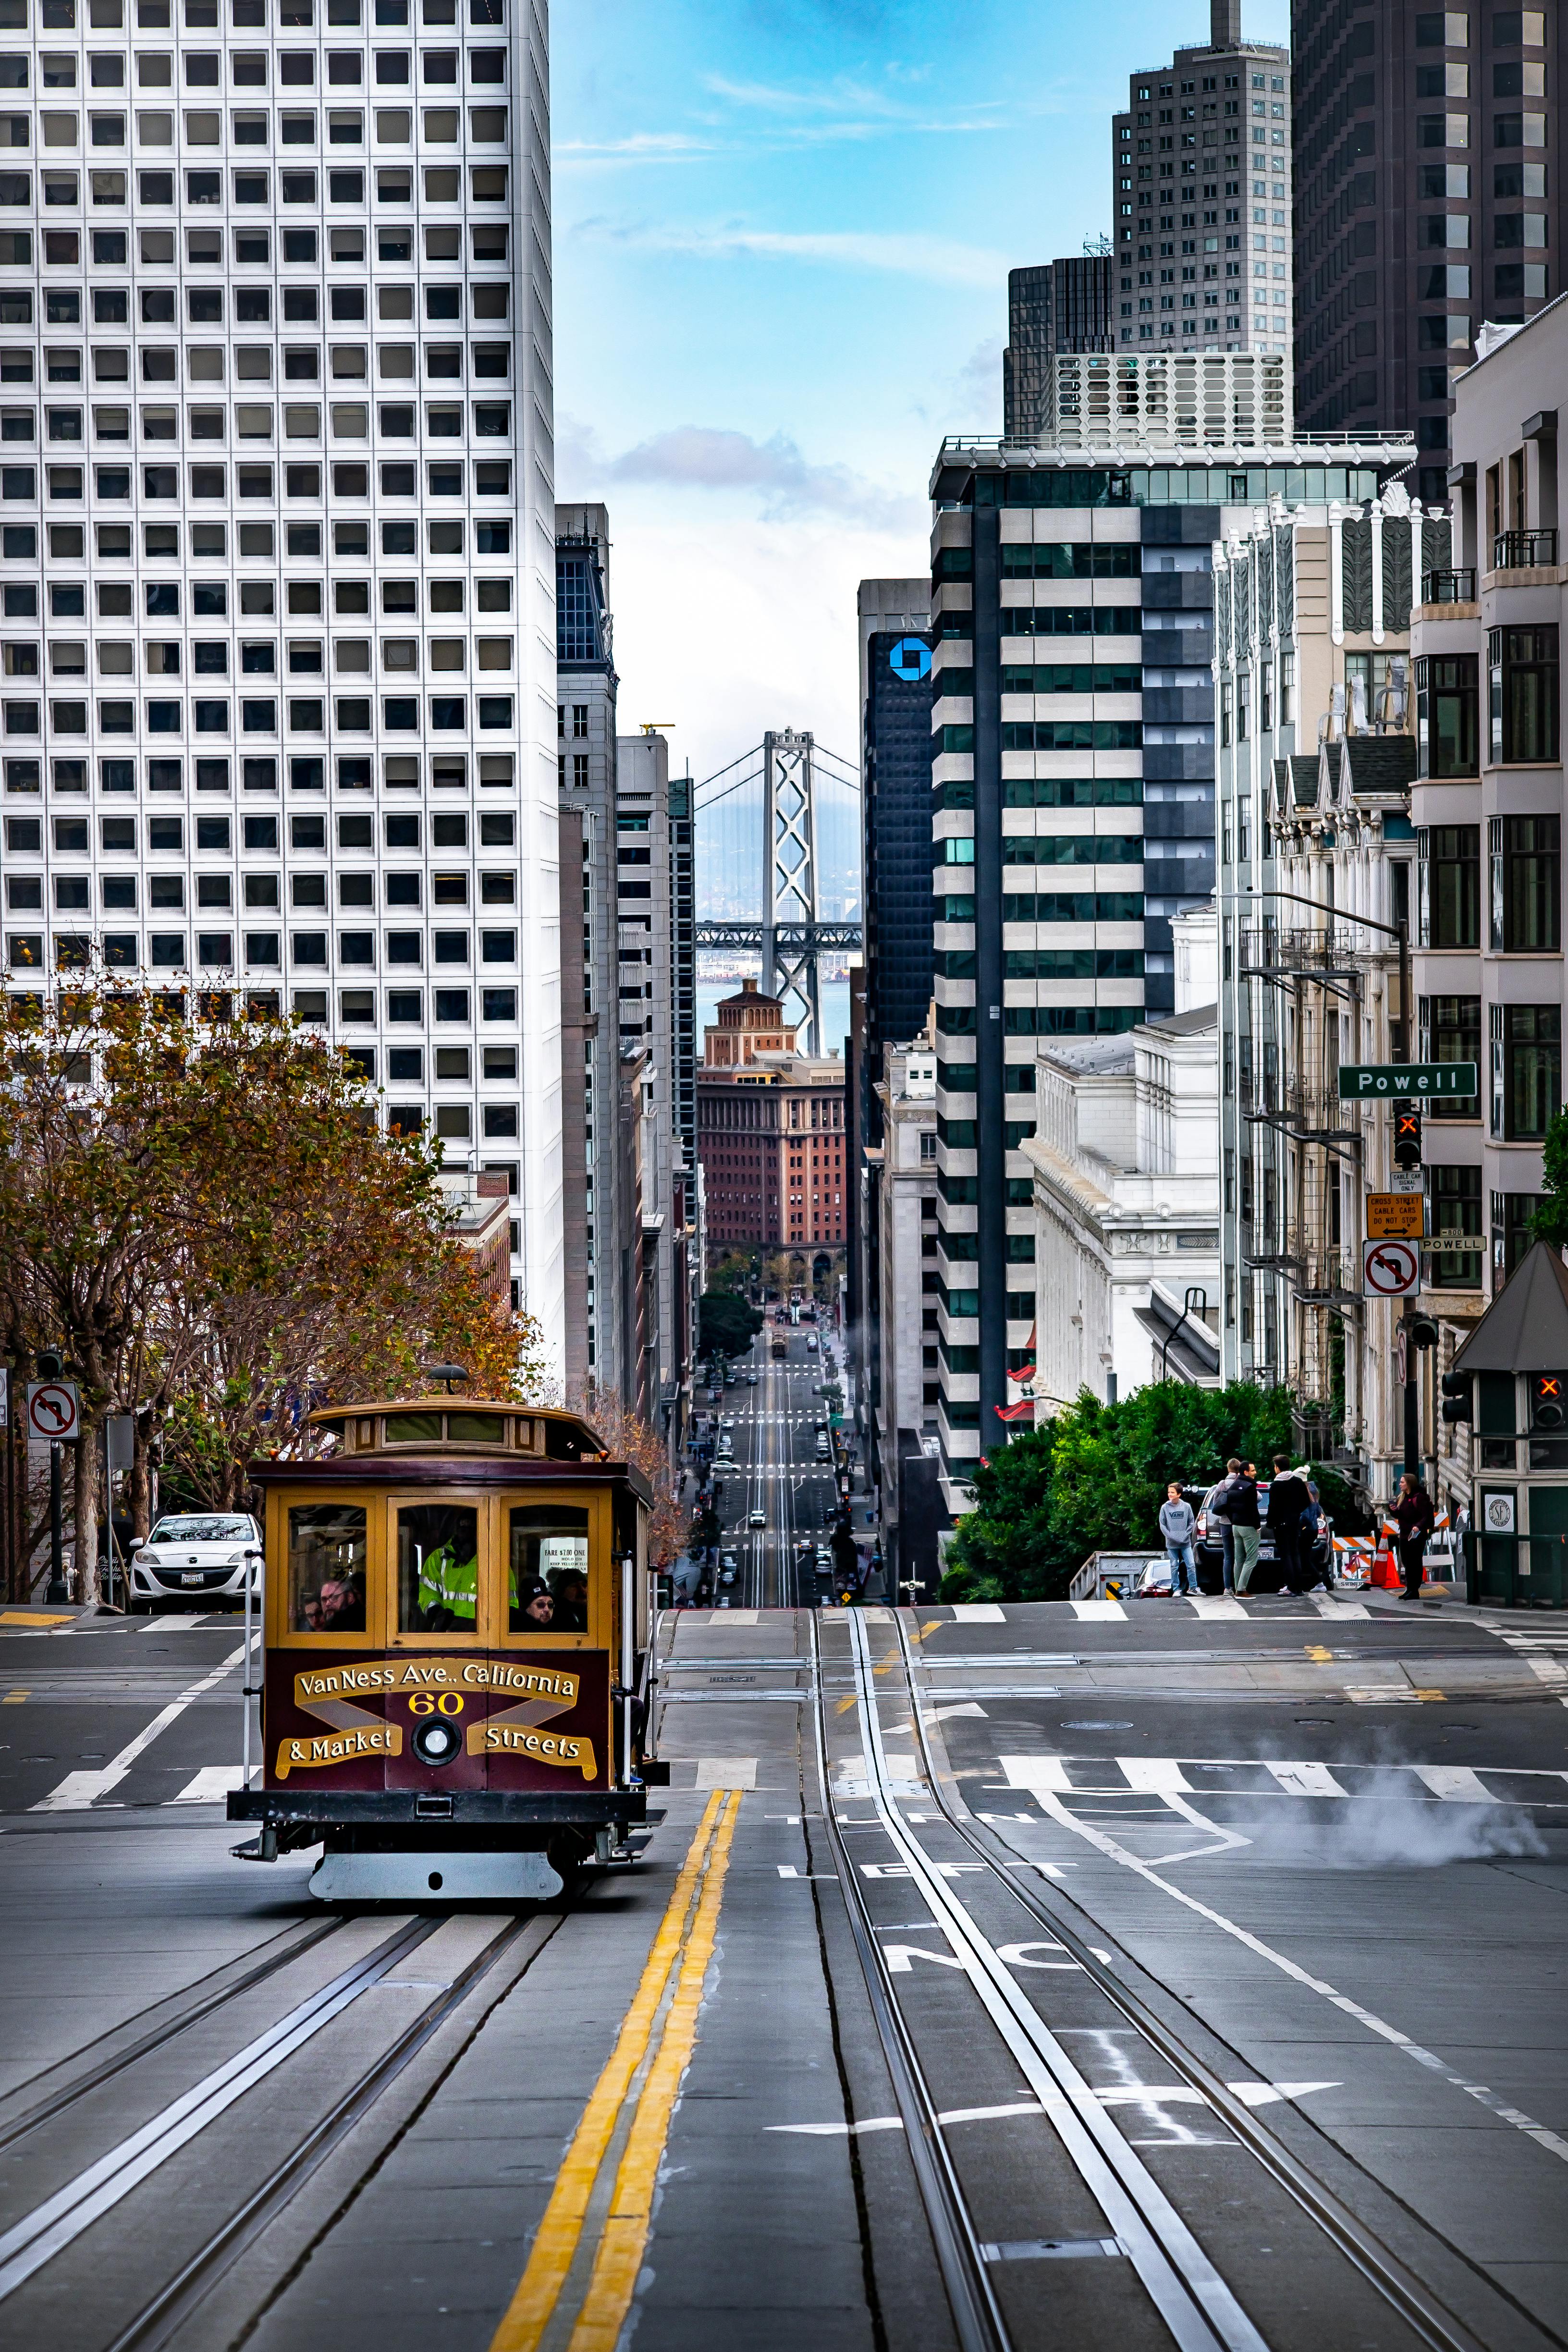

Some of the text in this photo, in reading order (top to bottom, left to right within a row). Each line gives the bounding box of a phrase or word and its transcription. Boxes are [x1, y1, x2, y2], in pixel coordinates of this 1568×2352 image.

[1359, 1072, 1456, 1090] Powell
[1423, 1239, 1481, 1249] POWELL
[1490, 1517, 1508, 1526] RAILWAY
[300, 1664, 575, 1696] Van Ness Ave., California
[408, 1692, 464, 1715] 60
[290, 1729, 392, 1760] & Market
[487, 1728, 580, 1757] Streets
[764, 1812, 1038, 1825] TURN
[777, 1862, 1080, 1879] LEFT
[882, 1941, 1113, 1972] NO
